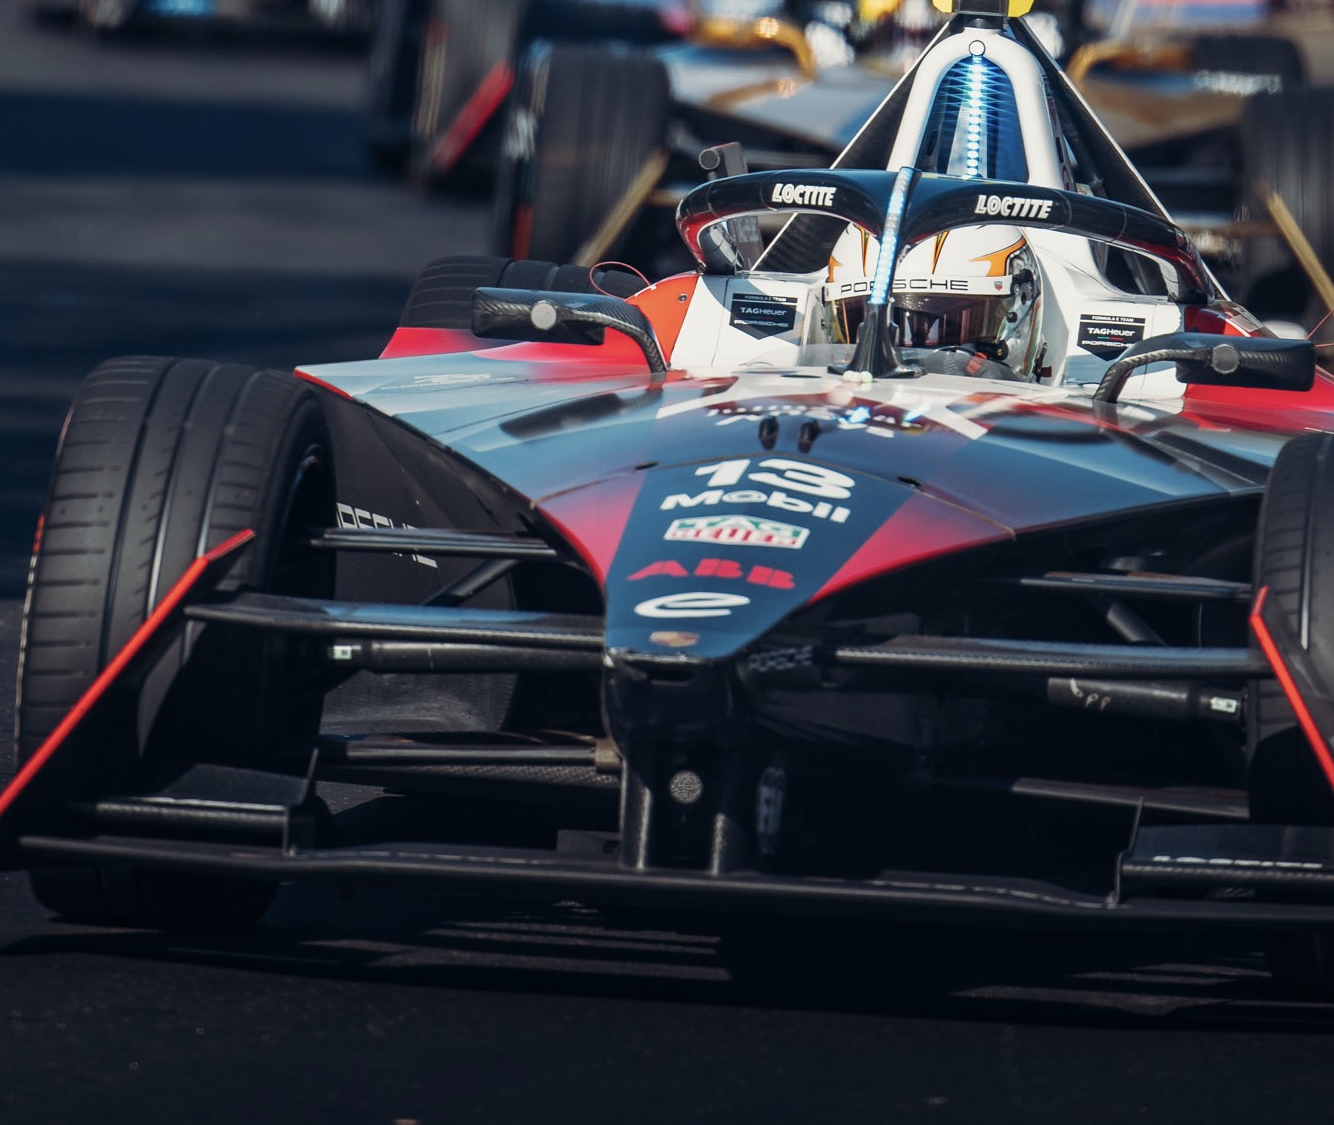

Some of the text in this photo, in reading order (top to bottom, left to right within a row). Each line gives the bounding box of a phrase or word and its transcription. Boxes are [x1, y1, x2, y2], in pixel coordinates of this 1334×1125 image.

[771, 183, 837, 207] LOCTITE
[974, 194, 1053, 219] LOCTITE
[740, 306, 787, 316] TAGHeuer
[1087, 327, 1135, 337] TAGHeuer
[694, 459, 856, 499] 13
[659, 489, 851, 523] Mobil
[677, 515, 803, 539] TAG
[626, 558, 795, 589] ABB
